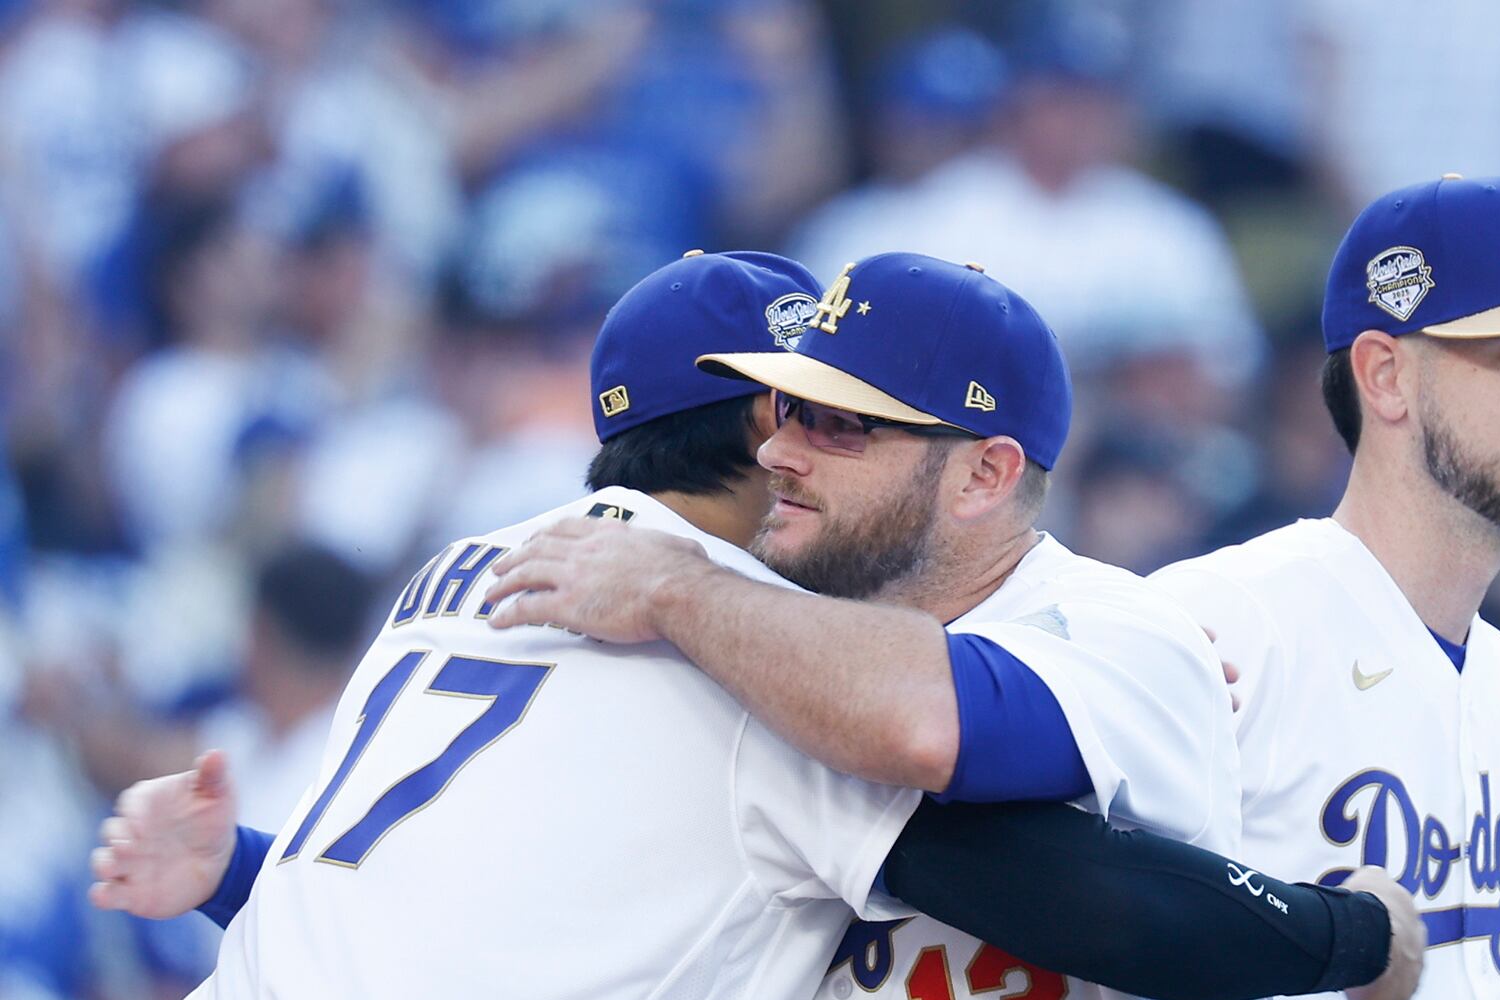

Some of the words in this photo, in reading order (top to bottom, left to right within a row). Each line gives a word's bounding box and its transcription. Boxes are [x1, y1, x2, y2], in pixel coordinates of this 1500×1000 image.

[808, 262, 857, 335] LA
[1377, 275, 1424, 294] CHAMPIONS
[276, 648, 557, 870] 17
